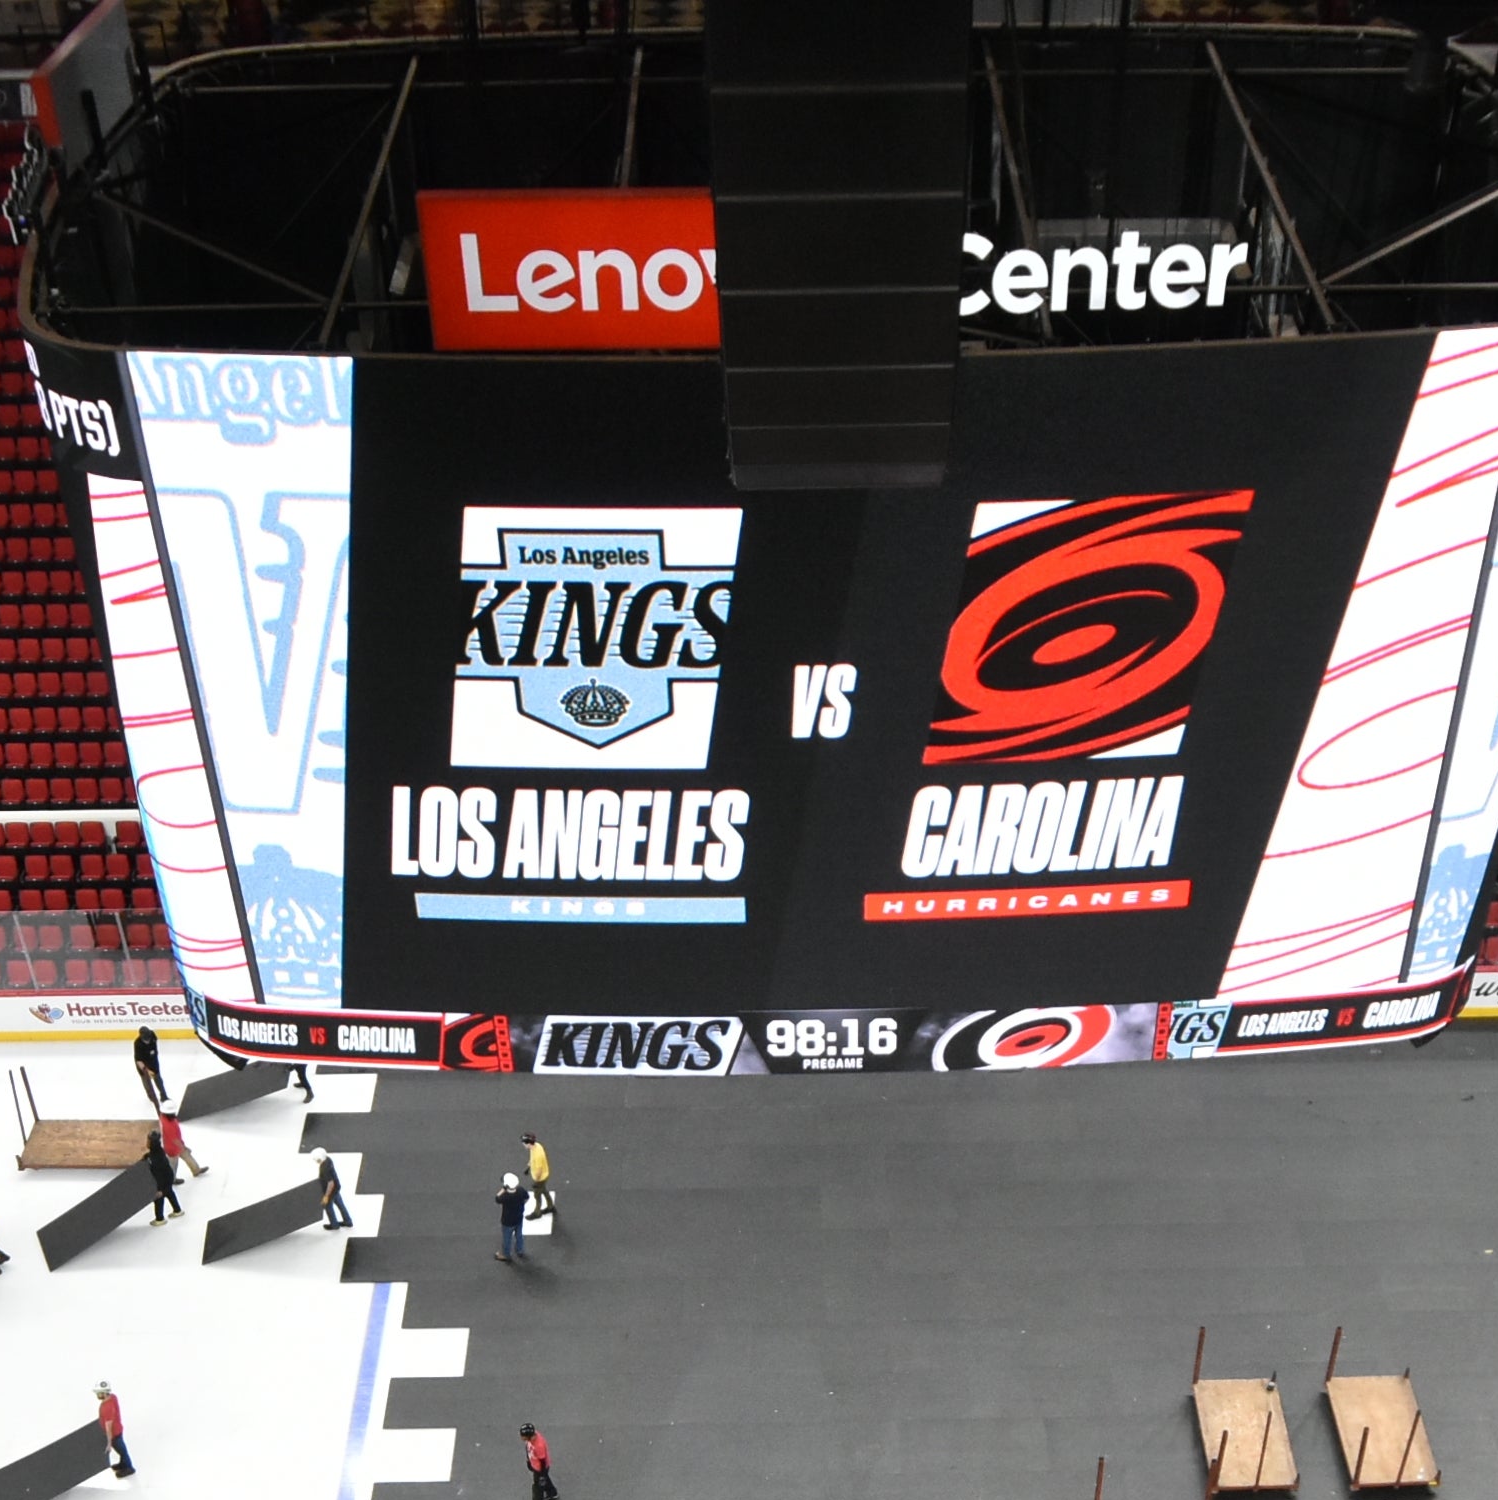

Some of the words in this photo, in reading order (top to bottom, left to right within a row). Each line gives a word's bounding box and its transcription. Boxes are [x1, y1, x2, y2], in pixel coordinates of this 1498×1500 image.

[48, 389, 120, 457] PTS)
[518, 545, 557, 566] Los
[561, 545, 650, 571] Angeles
[456, 580, 733, 670] KINGS
[791, 663, 858, 739] VS
[391, 785, 498, 878] LOS
[502, 787, 751, 881] ANGELES
[902, 775, 1185, 878] CAROLINA
[510, 900, 647, 916] KINGS
[882, 888, 1171, 914] HURRICANES
[66, 1002, 127, 1017] Harris
[1237, 1013, 1264, 1037] LOS
[1265, 1009, 1329, 1035] ANGELES
[1337, 1008, 1356, 1026] VS
[1363, 991, 1441, 1029] CAROLINA
[217, 1015, 241, 1038] LOS
[241, 1020, 299, 1046] ANGELES
[310, 1026, 326, 1045] VS
[338, 1024, 416, 1053] CAROLINA
[541, 1020, 731, 1070] KINGS
[766, 1017, 898, 1057] 98:16
[803, 1058, 863, 1070] PREGAME
